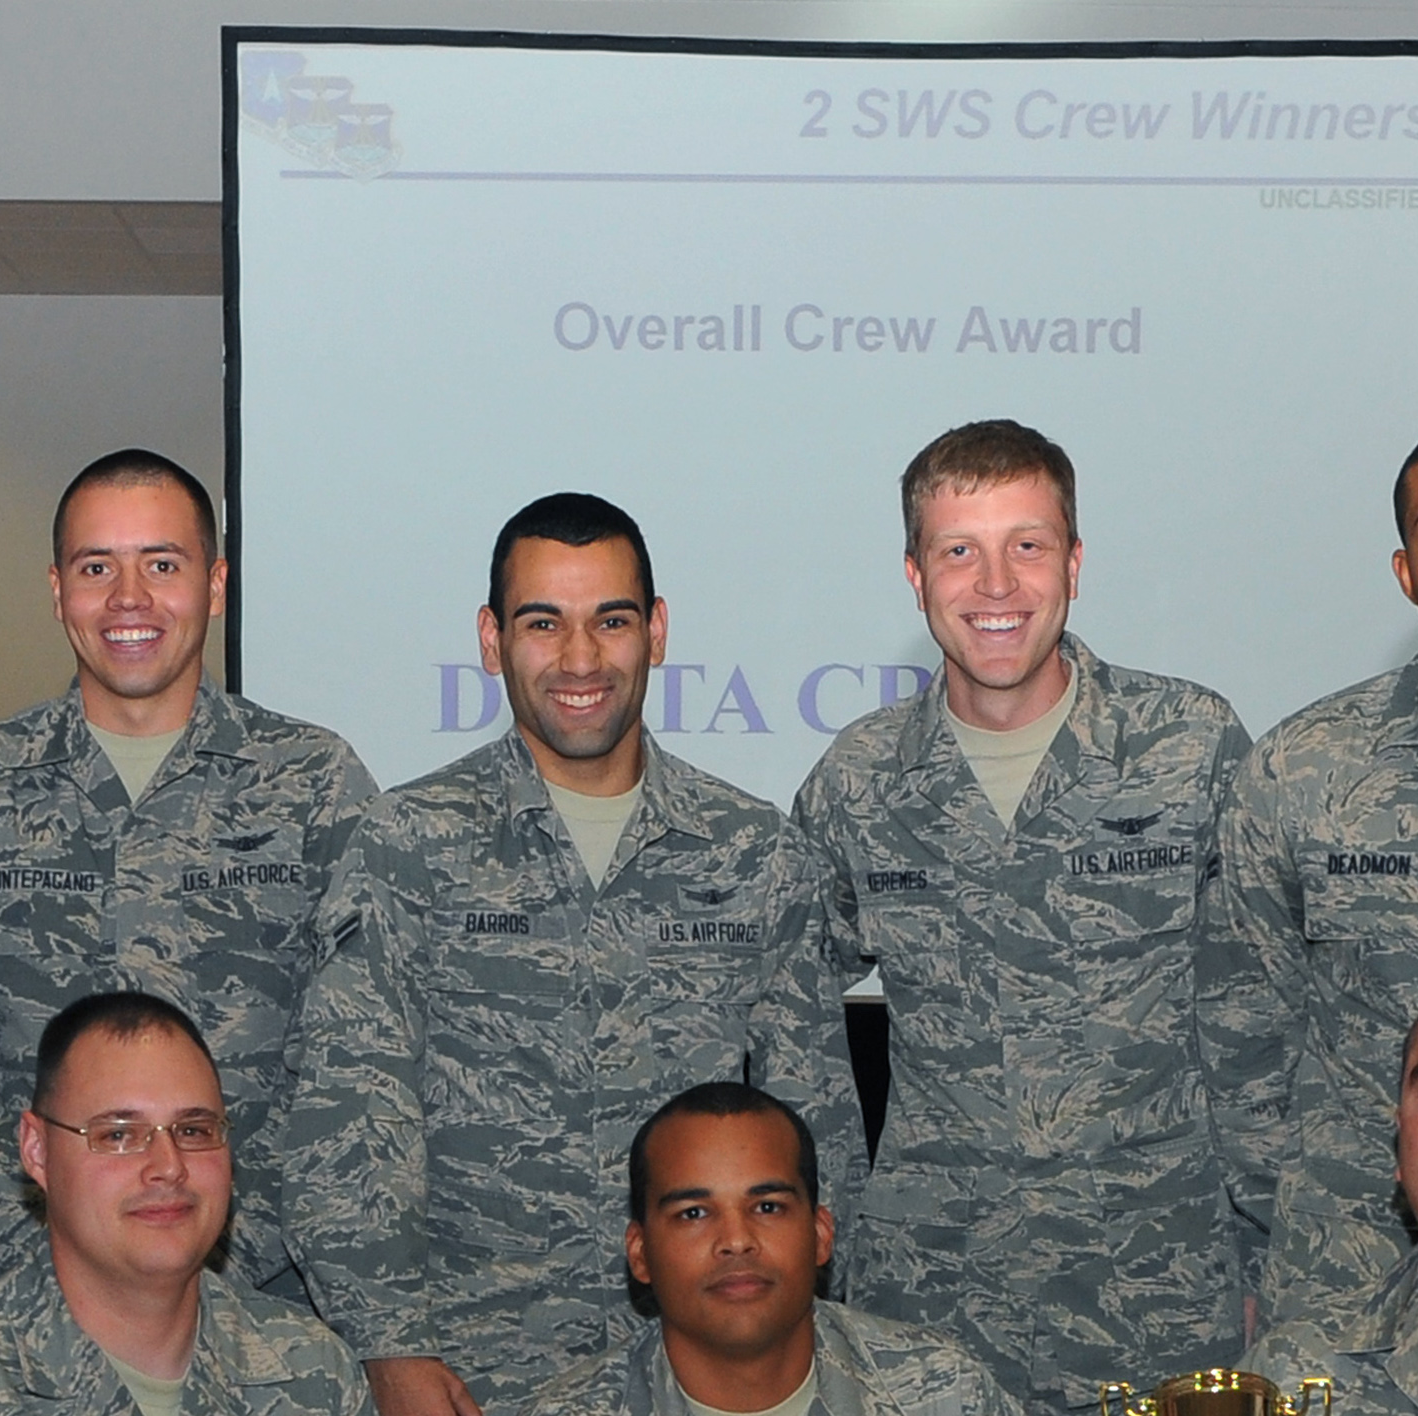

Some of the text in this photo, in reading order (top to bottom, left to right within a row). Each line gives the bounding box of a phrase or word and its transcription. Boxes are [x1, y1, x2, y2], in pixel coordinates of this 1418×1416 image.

[799, 89, 833, 139] 2
[851, 88, 993, 140] SWS
[1014, 88, 1171, 140] Crew
[553, 301, 1142, 354] Overall Crew Award
[431, 664, 775, 734] DTA
[1071, 845, 1192, 875] U.S. AIR FORCE
[1327, 853, 1411, 875] DEADMON
[183, 864, 302, 892] U.S. AIR FORCE
[465, 912, 530, 935] BARROS
[659, 922, 760, 944] U.S. AIR FORCE
